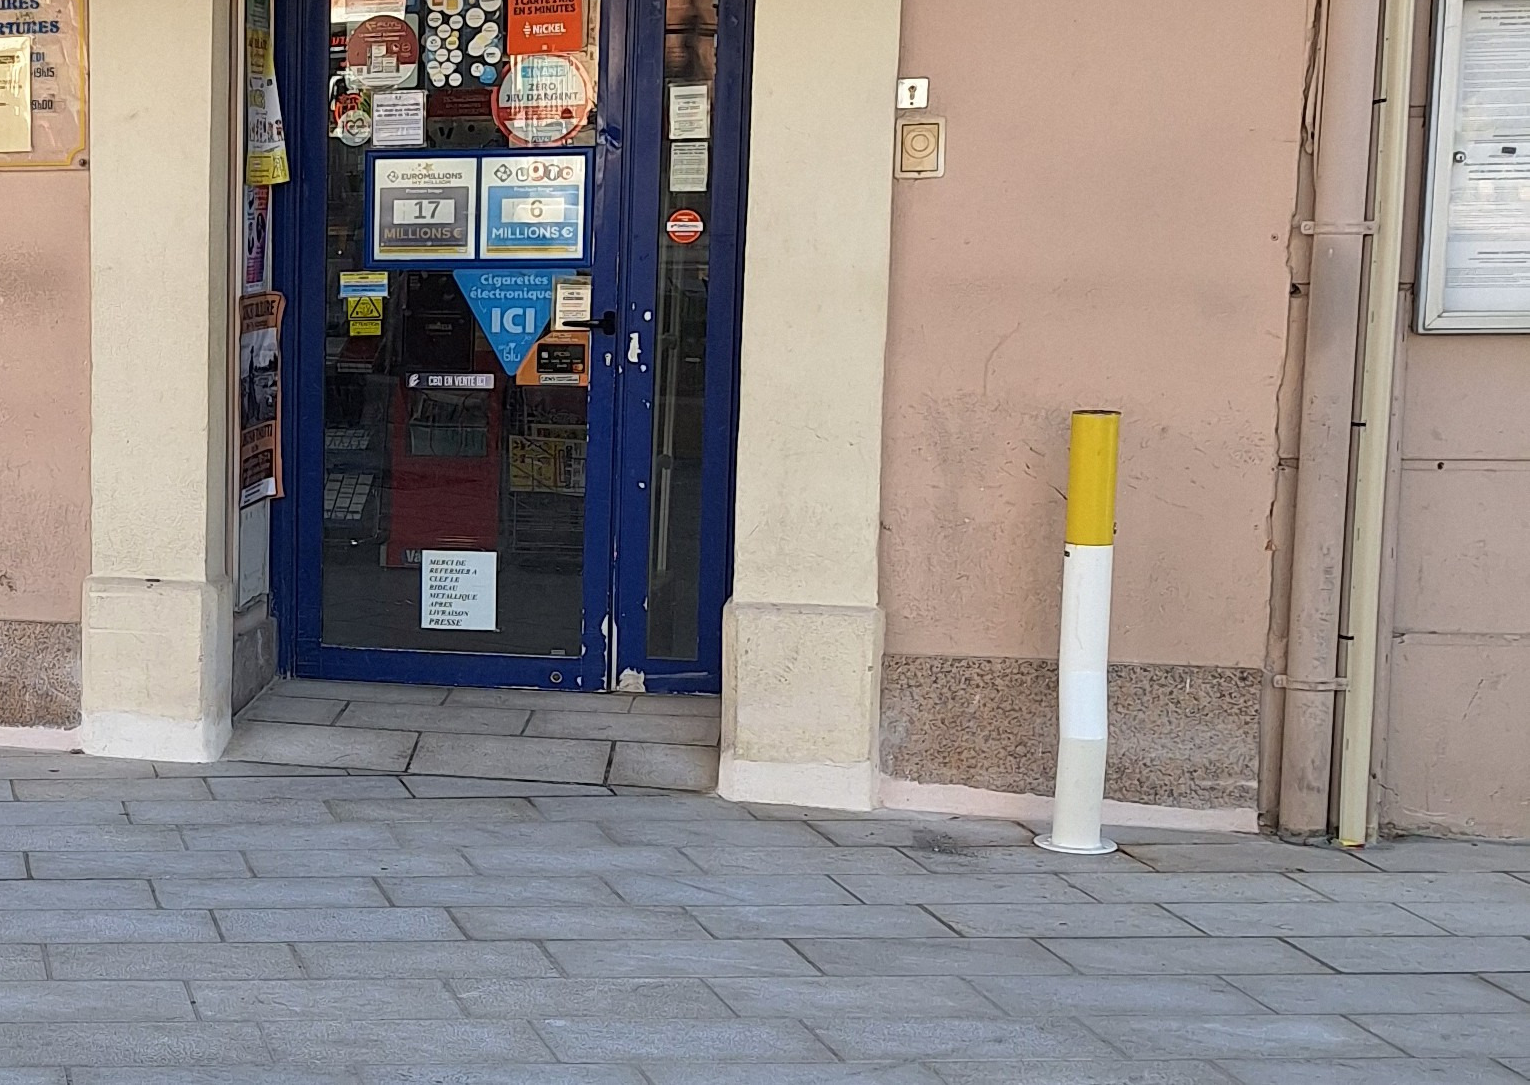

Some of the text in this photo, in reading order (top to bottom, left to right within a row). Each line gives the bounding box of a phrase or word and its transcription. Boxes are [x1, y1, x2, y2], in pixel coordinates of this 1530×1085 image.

[513, 3, 576, 16] EN 5 MINUTES
[400, 172, 463, 181] EUROMILLIONS
[515, 160, 574, 182] LOTO
[413, 200, 441, 220] 17
[529, 199, 544, 219] 6
[383, 227, 451, 239] MILLIONS
[491, 226, 560, 239] MILLIONS
[480, 274, 549, 288] Cigarettes
[491, 307, 536, 334] ICI
[454, 375, 477, 387] VENTE
[428, 559, 467, 567] MERCI DE
[429, 575, 450, 583] CLEF
[428, 584, 459, 592] RIDEAU
[428, 609, 470, 617] LIVRAISON
[428, 618, 463, 627] PRESSE
